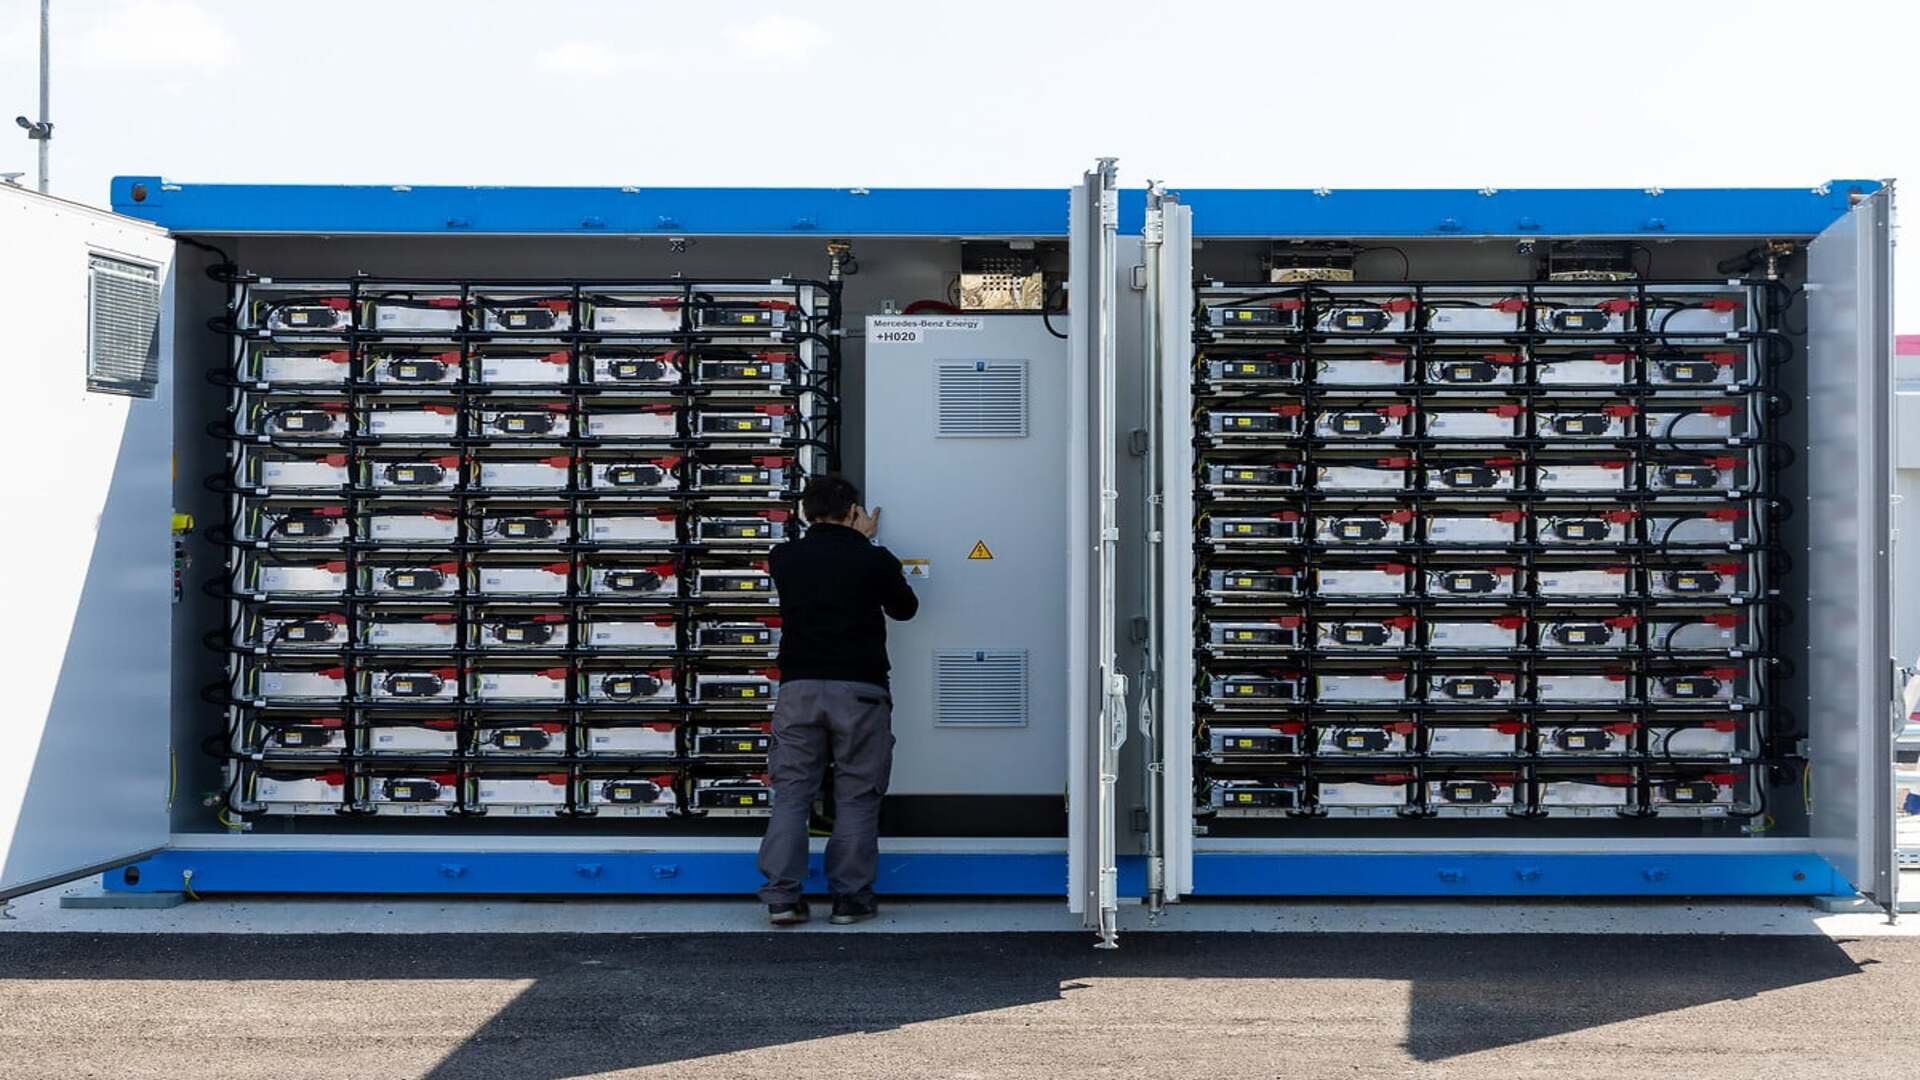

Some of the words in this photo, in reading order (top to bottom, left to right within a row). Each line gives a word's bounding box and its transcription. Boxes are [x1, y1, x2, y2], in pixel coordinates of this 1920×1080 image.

[874, 320, 944, 328] Mercedes-Benz
[946, 320, 978, 329] Energy
[877, 332, 916, 341] +H020
